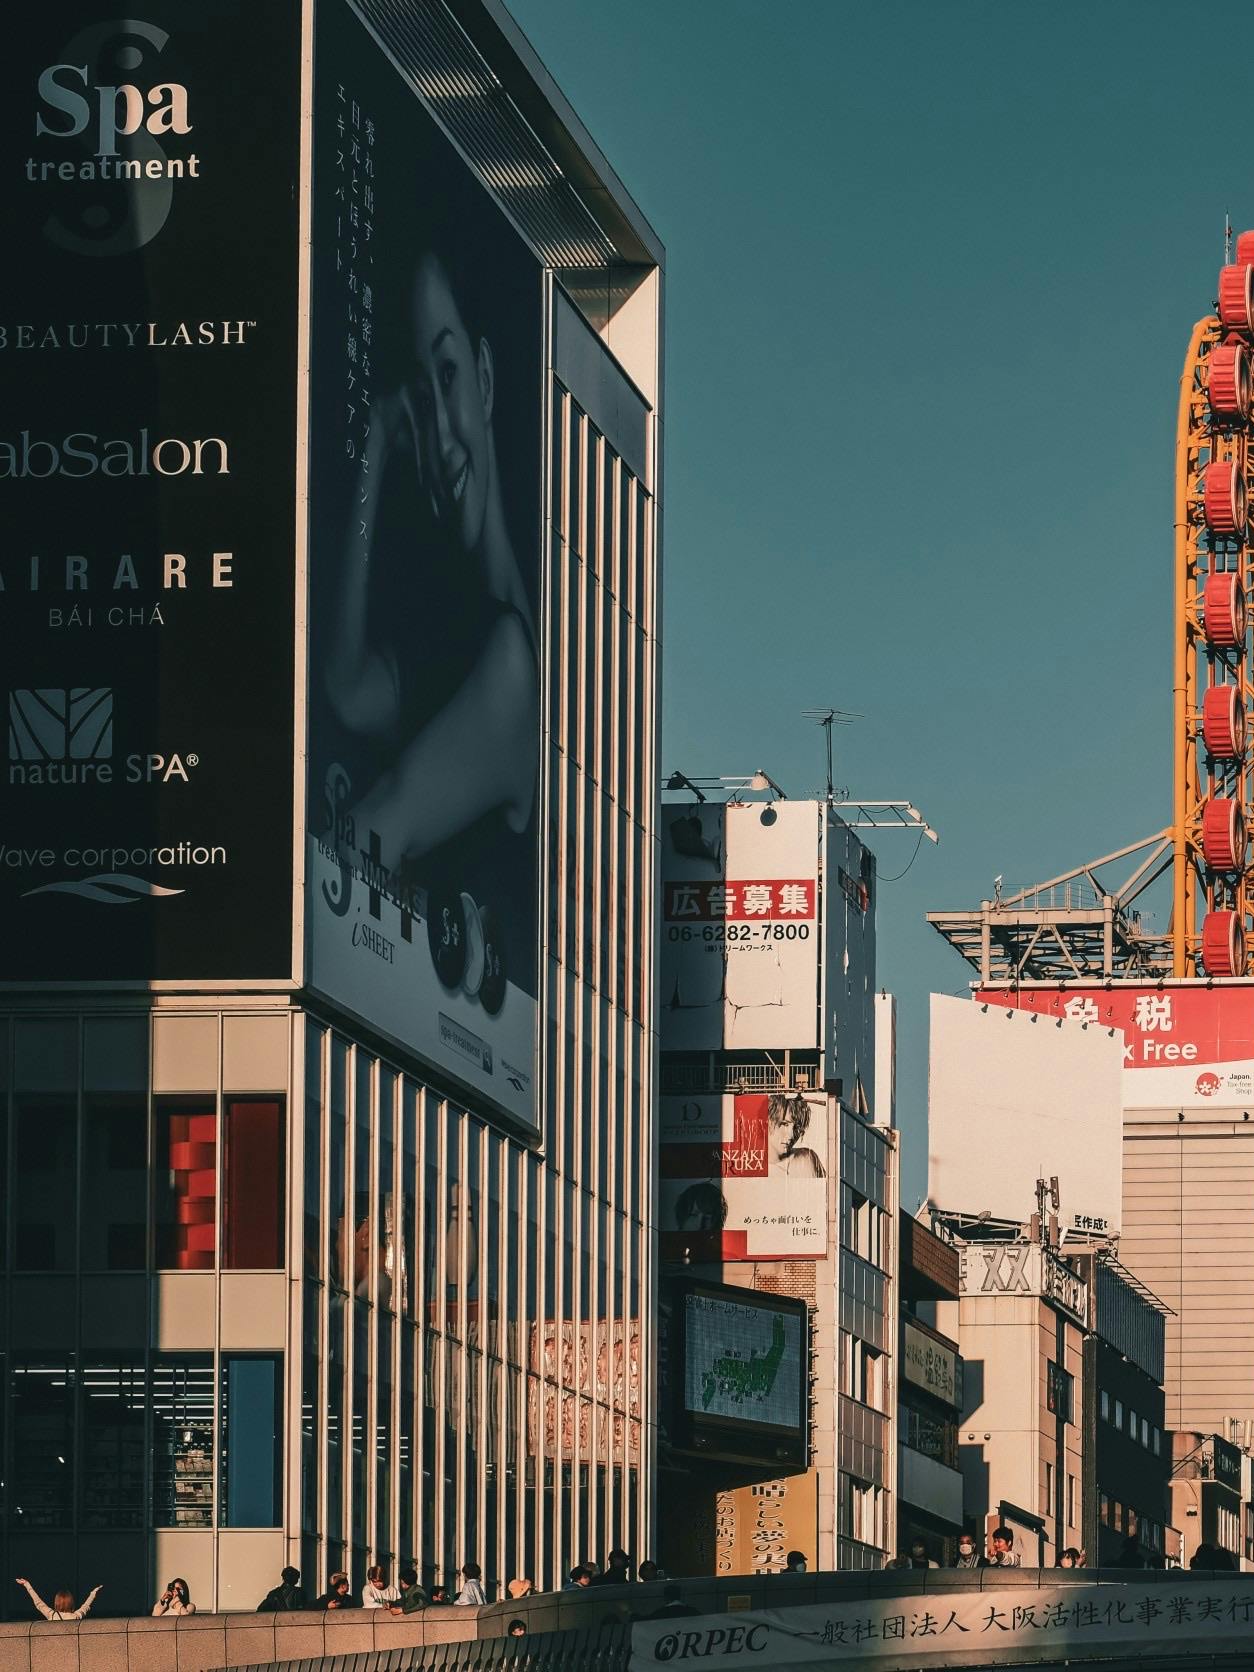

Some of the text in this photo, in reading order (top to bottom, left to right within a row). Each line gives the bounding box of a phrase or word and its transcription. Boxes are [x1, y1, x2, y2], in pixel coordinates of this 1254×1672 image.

[36, 64, 193, 157] Spa
[25, 153, 200, 181] treatment
[335, 82, 346, 271] エキスパート
[0, 552, 233, 591] IRARE
[9, 762, 112, 784] nature
[63, 841, 226, 871] corporation
[671, 884, 808, 917] 広告募集
[668, 924, 809, 942] 06-6282-7800
[1143, 1040, 1198, 1061] Free
[743, 1215, 812, 1225] めっちゃ面白いを
[793, 1611, 969, 1644] 一般社団法人
